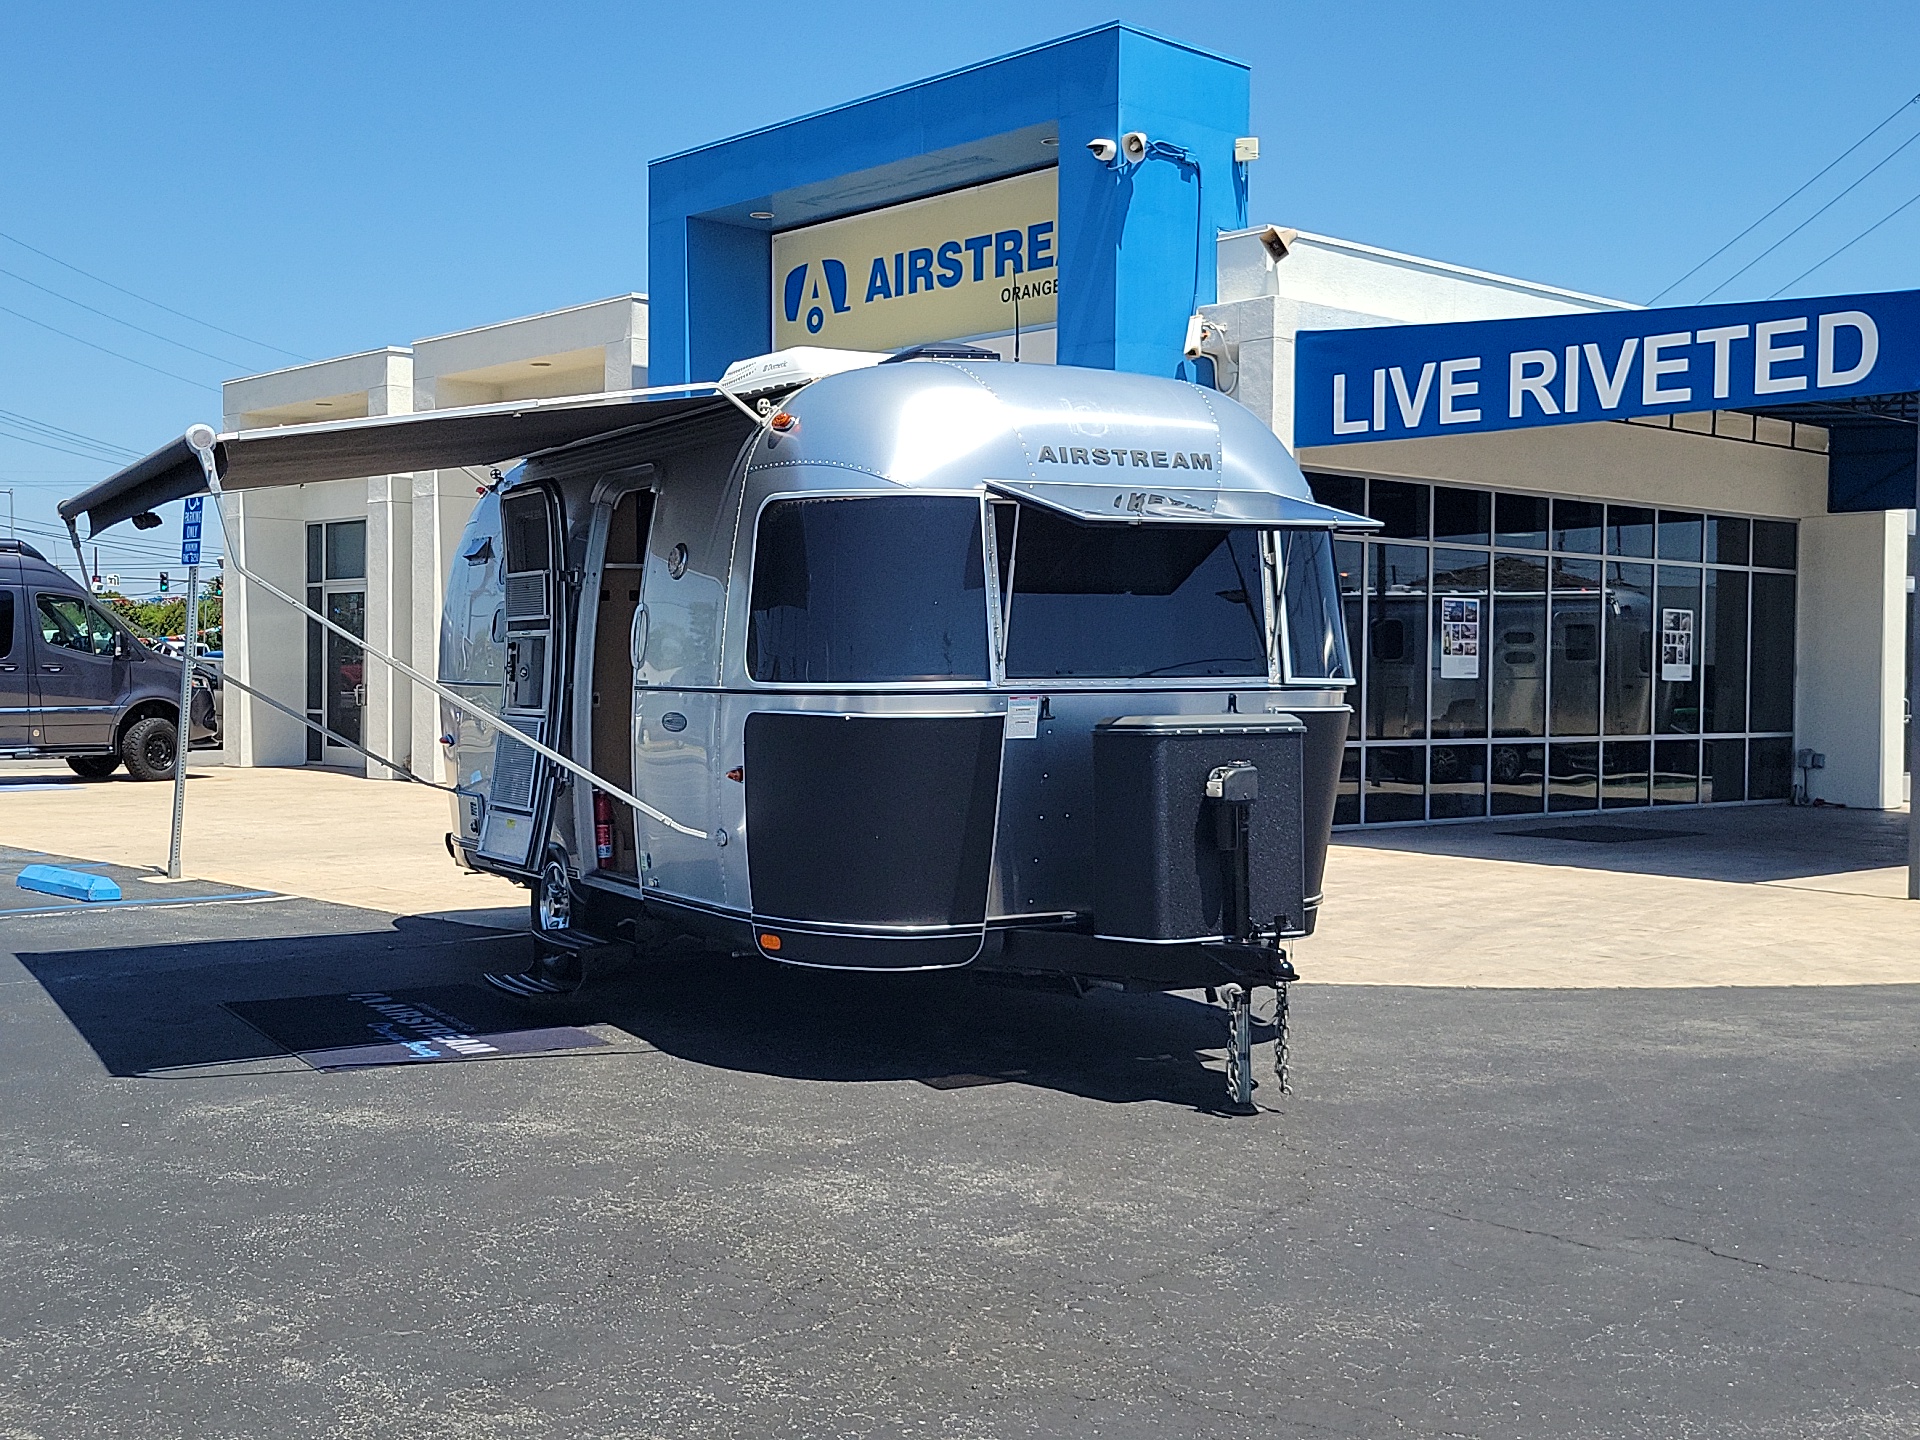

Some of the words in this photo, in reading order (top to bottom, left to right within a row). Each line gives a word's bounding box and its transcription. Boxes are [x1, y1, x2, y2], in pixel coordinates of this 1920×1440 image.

[864, 220, 1058, 303] AIRSTRE
[1000, 280, 1058, 303] ORANGE
[1332, 356, 1481, 435] LIVE
[1508, 310, 1880, 418] RIVETED
[1038, 445, 1213, 470] AIRSTREAM
[186, 525, 199, 539] ONLY
